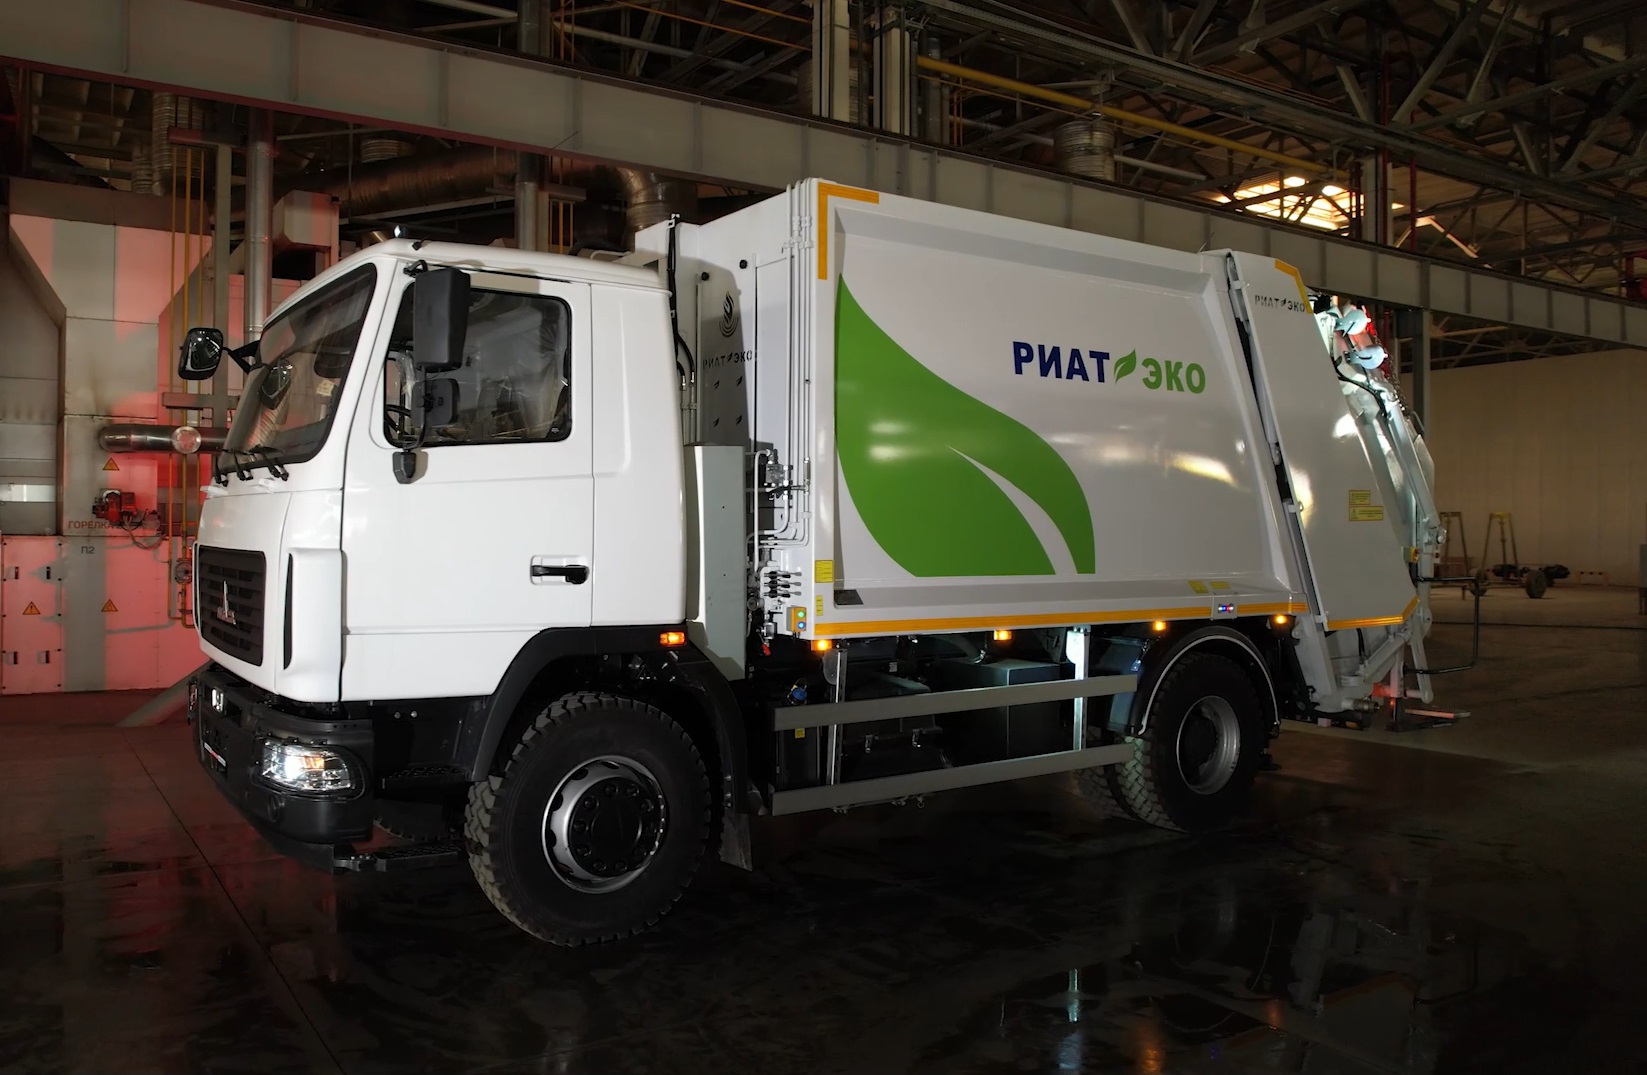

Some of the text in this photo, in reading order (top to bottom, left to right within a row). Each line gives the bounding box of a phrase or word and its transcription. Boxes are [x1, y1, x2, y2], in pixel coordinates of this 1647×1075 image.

[1255, 295, 1305, 312] РИАТ ЭКО
[702, 350, 752, 370] РИАТ ЭКО
[1013, 341, 1206, 394] РИАТ ЭКО
[81, 546, 95, 554] П2
